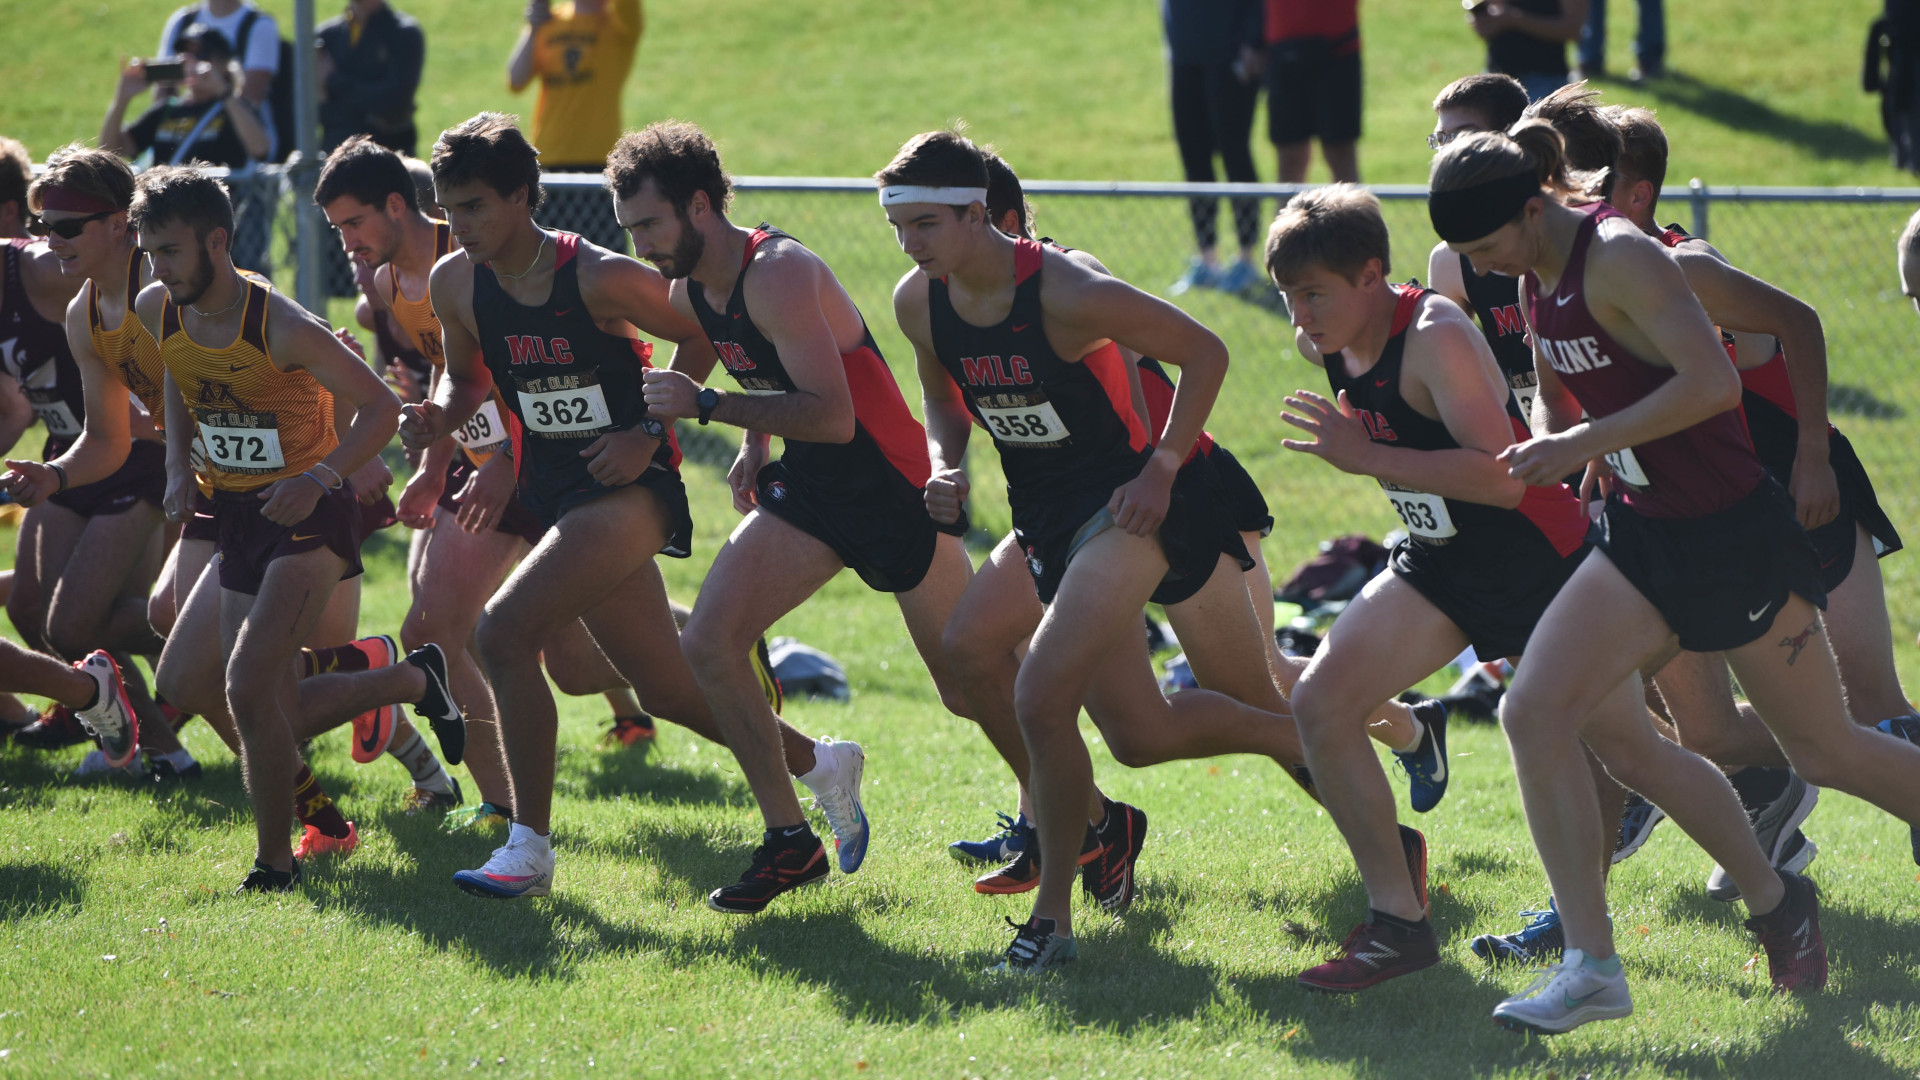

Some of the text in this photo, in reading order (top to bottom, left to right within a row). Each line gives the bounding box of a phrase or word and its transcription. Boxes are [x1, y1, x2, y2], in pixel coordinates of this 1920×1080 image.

[505, 335, 574, 365] MLC
[547, 375, 580, 390] OLAF
[960, 355, 1034, 386] MLC
[206, 412, 259, 429] ST. OLAF
[532, 397, 594, 426] 362
[988, 414, 1049, 437] 358
[211, 434, 268, 462] 372
